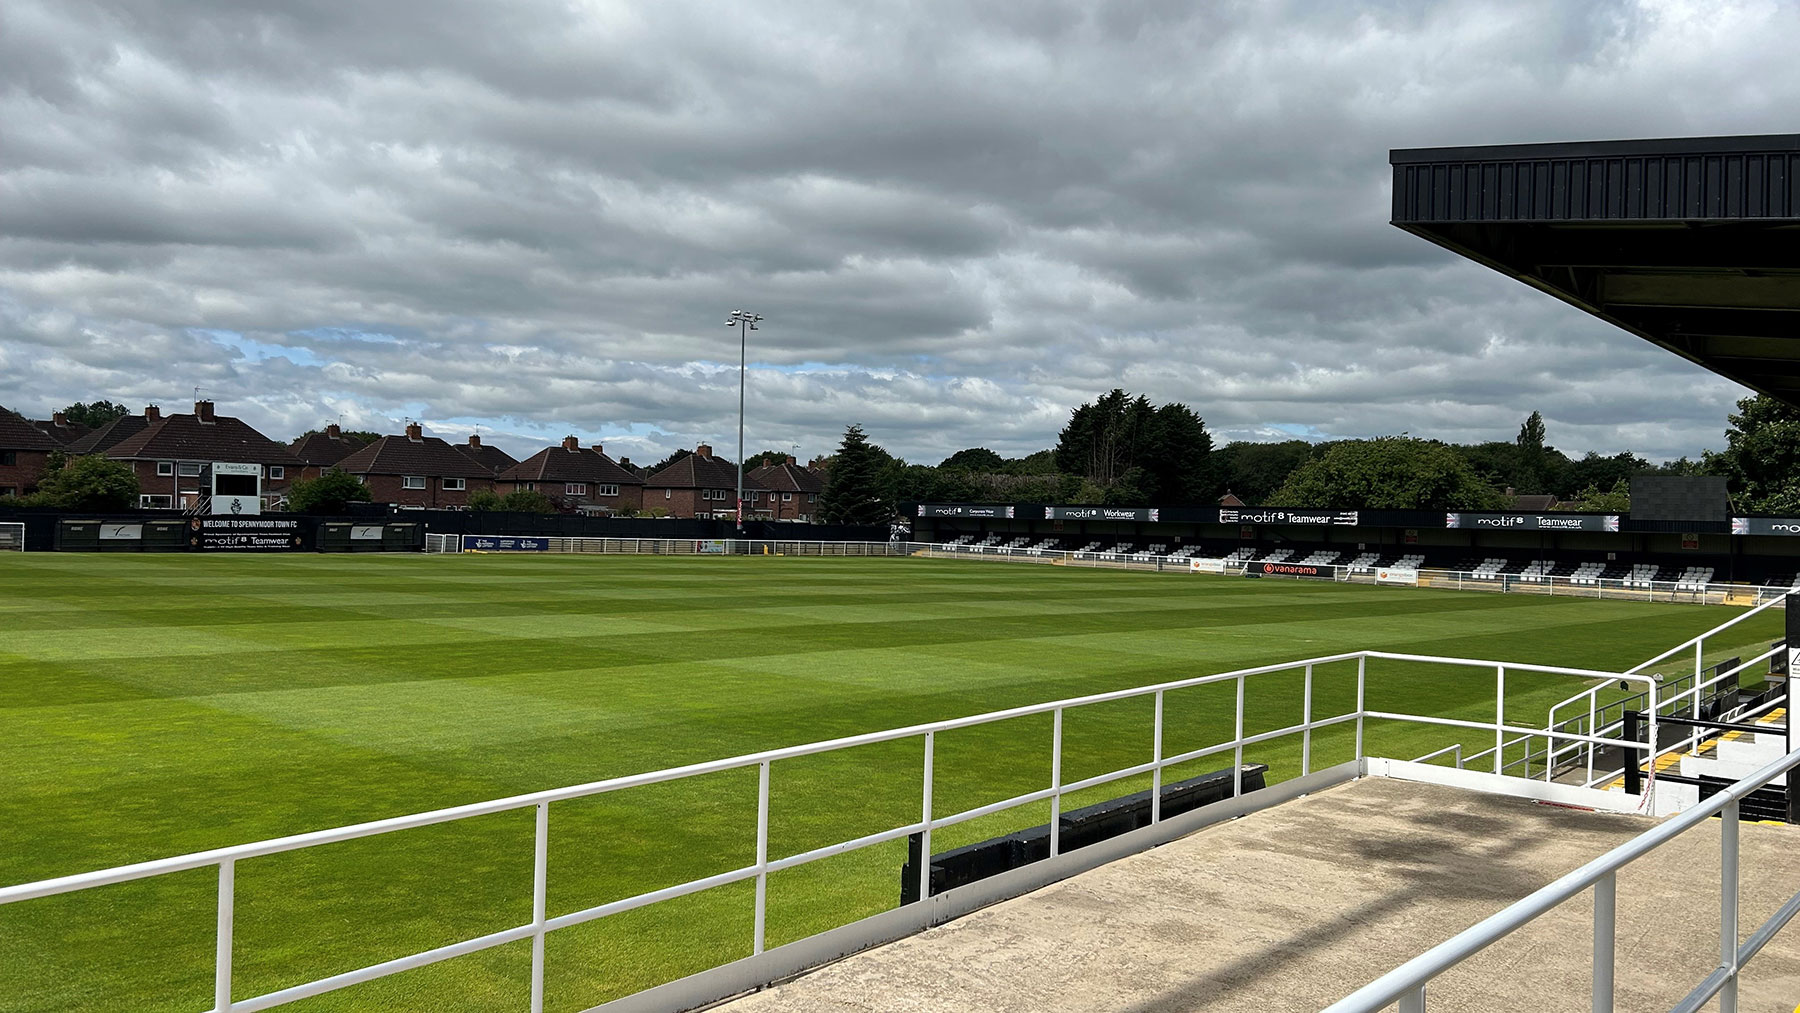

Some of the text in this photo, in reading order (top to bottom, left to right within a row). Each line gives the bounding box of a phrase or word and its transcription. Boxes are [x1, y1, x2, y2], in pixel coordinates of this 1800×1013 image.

[1103, 509, 1135, 517] Workwear
[1286, 513, 1330, 523] Teamwear
[1536, 516, 1582, 526] Teamwear
[203, 520, 229, 528] WELCOME
[239, 520, 274, 528] SPENNYMOOR
[251, 536, 289, 545] Teamwear
[1274, 565, 1317, 575] vanarama
